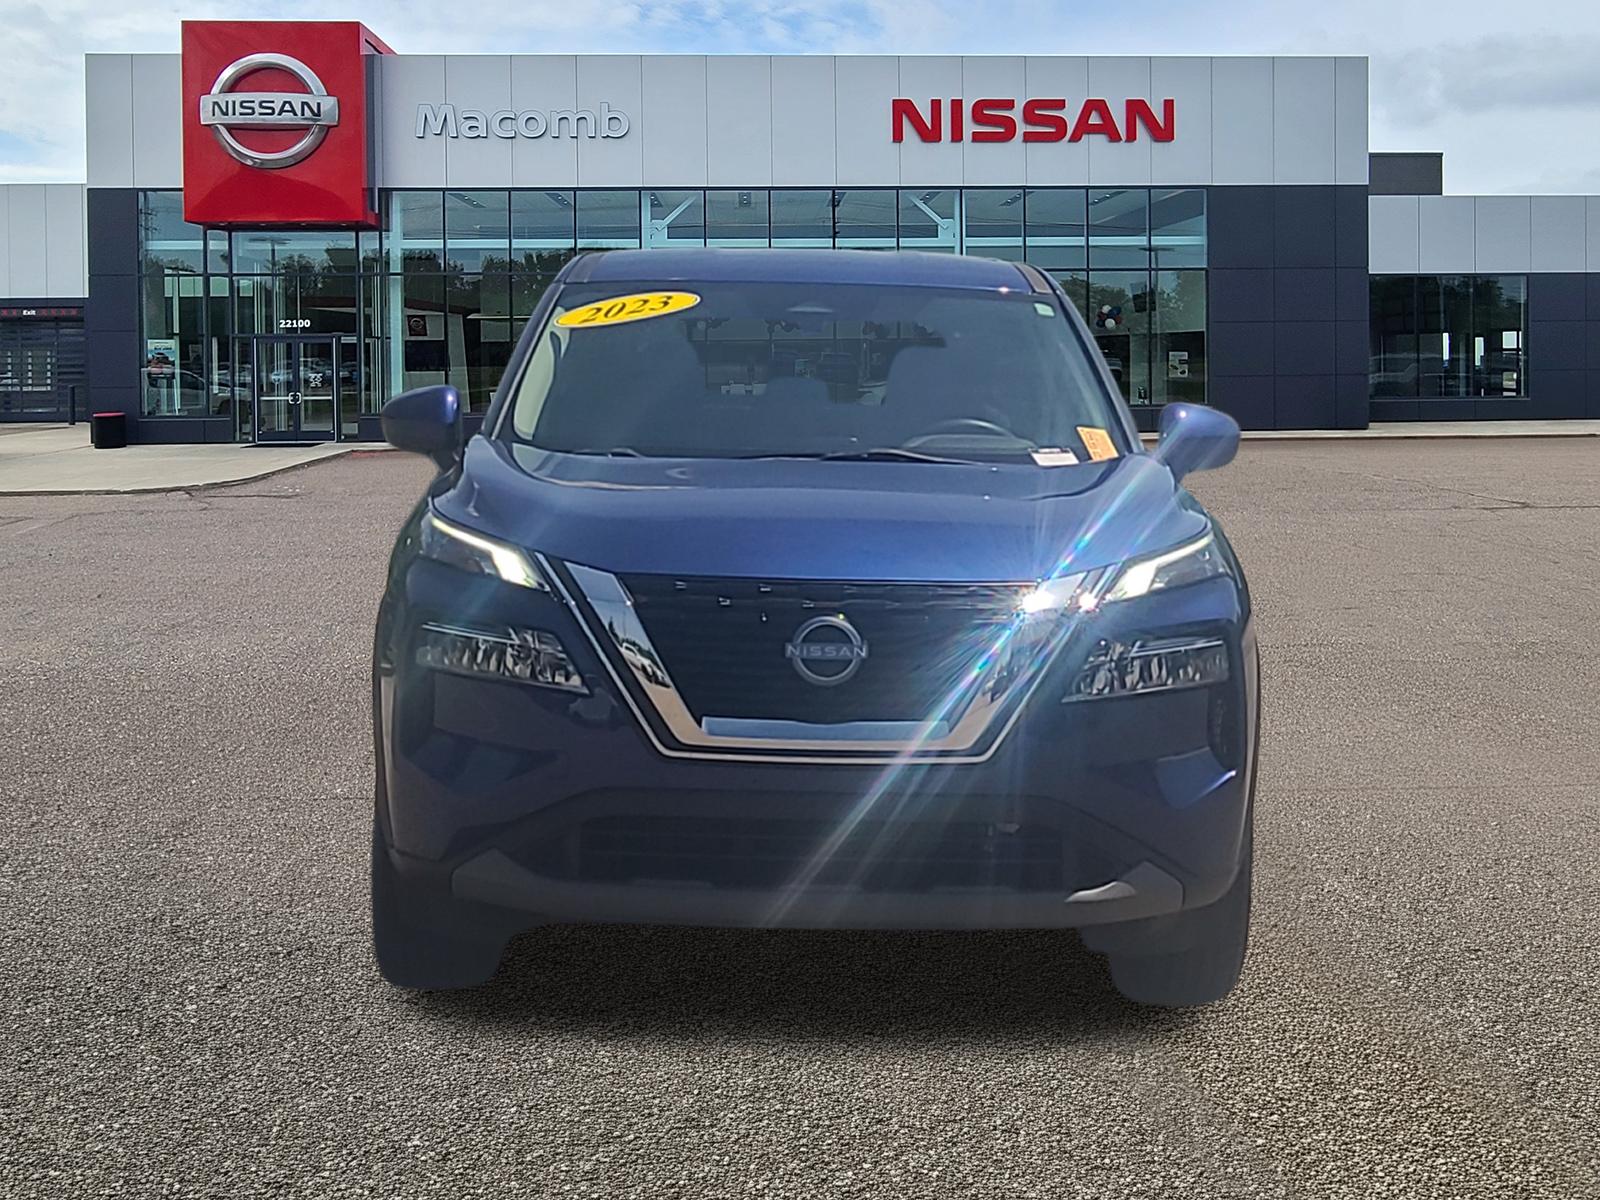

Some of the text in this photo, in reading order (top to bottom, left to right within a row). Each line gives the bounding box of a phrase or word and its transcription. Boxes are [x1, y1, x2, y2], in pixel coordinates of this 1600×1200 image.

[211, 100, 322, 119] NISSAN
[415, 101, 630, 139] Macomb
[892, 98, 1175, 142] NISSAN
[578, 296, 673, 324] 2023
[279, 319, 311, 328] 22100
[786, 644, 867, 658] NISSAN
